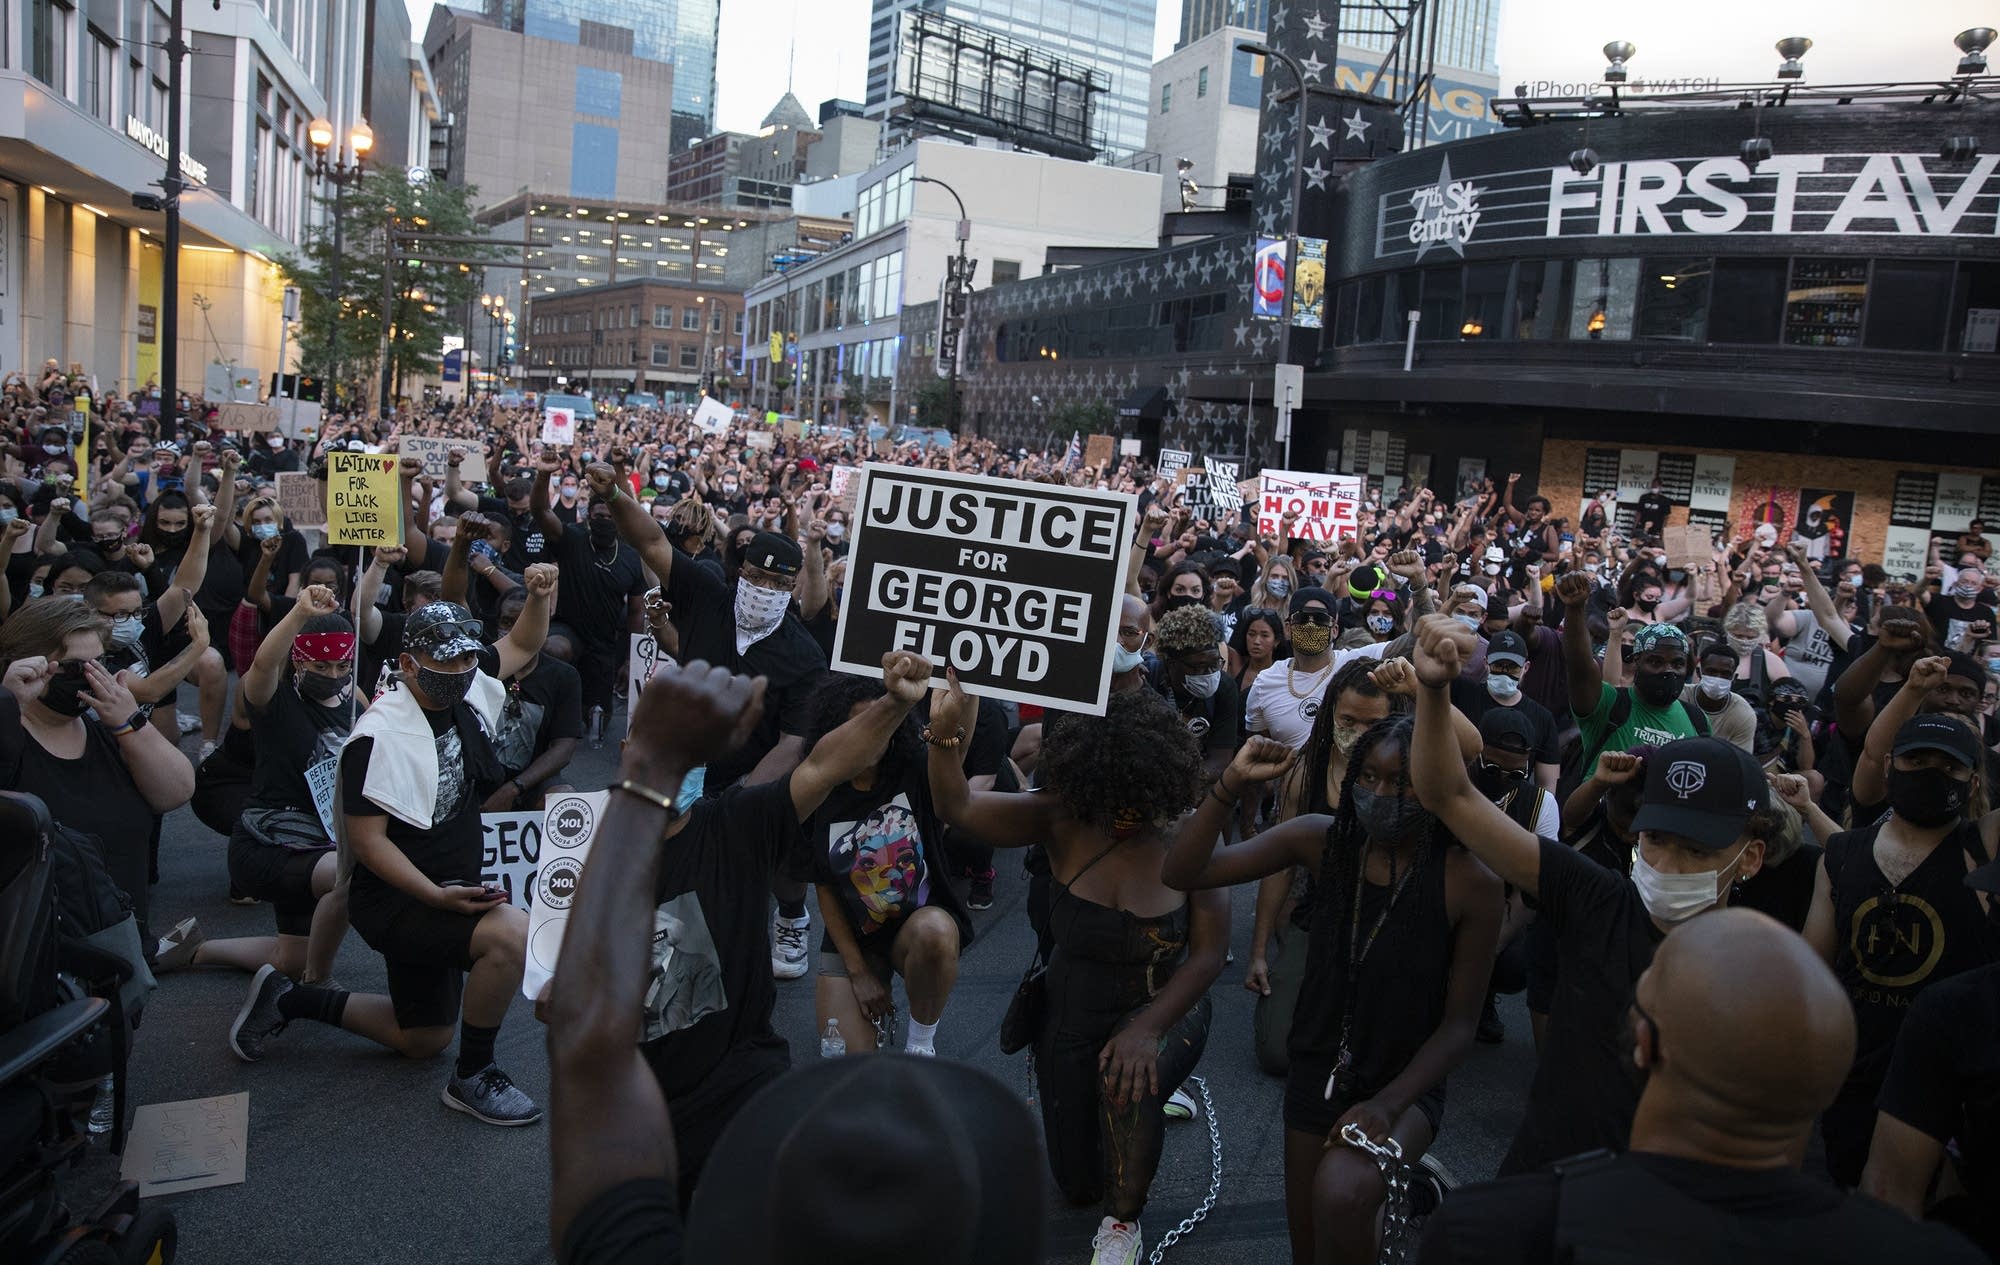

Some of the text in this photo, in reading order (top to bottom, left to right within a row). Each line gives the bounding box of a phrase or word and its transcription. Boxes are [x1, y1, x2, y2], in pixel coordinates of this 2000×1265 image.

[1530, 77, 1719, 98] iPhone WATCH
[127, 114, 153, 150] MAYO
[1410, 181, 1479, 220] 7th St
[1545, 154, 2000, 238] FIRST AV
[1409, 209, 1480, 244] entry
[407, 438, 439, 452] STOP
[335, 454, 381, 473] LATINX
[1204, 455, 1236, 483] BLACK
[348, 476, 370, 491] FOR
[1187, 474, 1210, 488] BLA
[1207, 473, 1240, 497] LIVES
[1265, 477, 1295, 495] LAND
[1329, 482, 1355, 499] FREE
[335, 492, 379, 508] BLACK
[1185, 489, 1212, 504] LIV
[1264, 495, 1352, 520] HOME
[344, 511, 378, 524] LIVES
[872, 484, 1116, 555] JUSTICE
[339, 528, 385, 540] MATTER
[958, 548, 1008, 573] FOR
[878, 569, 1083, 637] GEORGE
[892, 619, 1050, 683] FLOYD
[309, 759, 338, 781] BETTER
[313, 776, 327, 791] DIE
[316, 786, 331, 807] FEET
[559, 818, 582, 828] 10K
[481, 820, 541, 868] GEO
[551, 878, 575, 888] 10K
